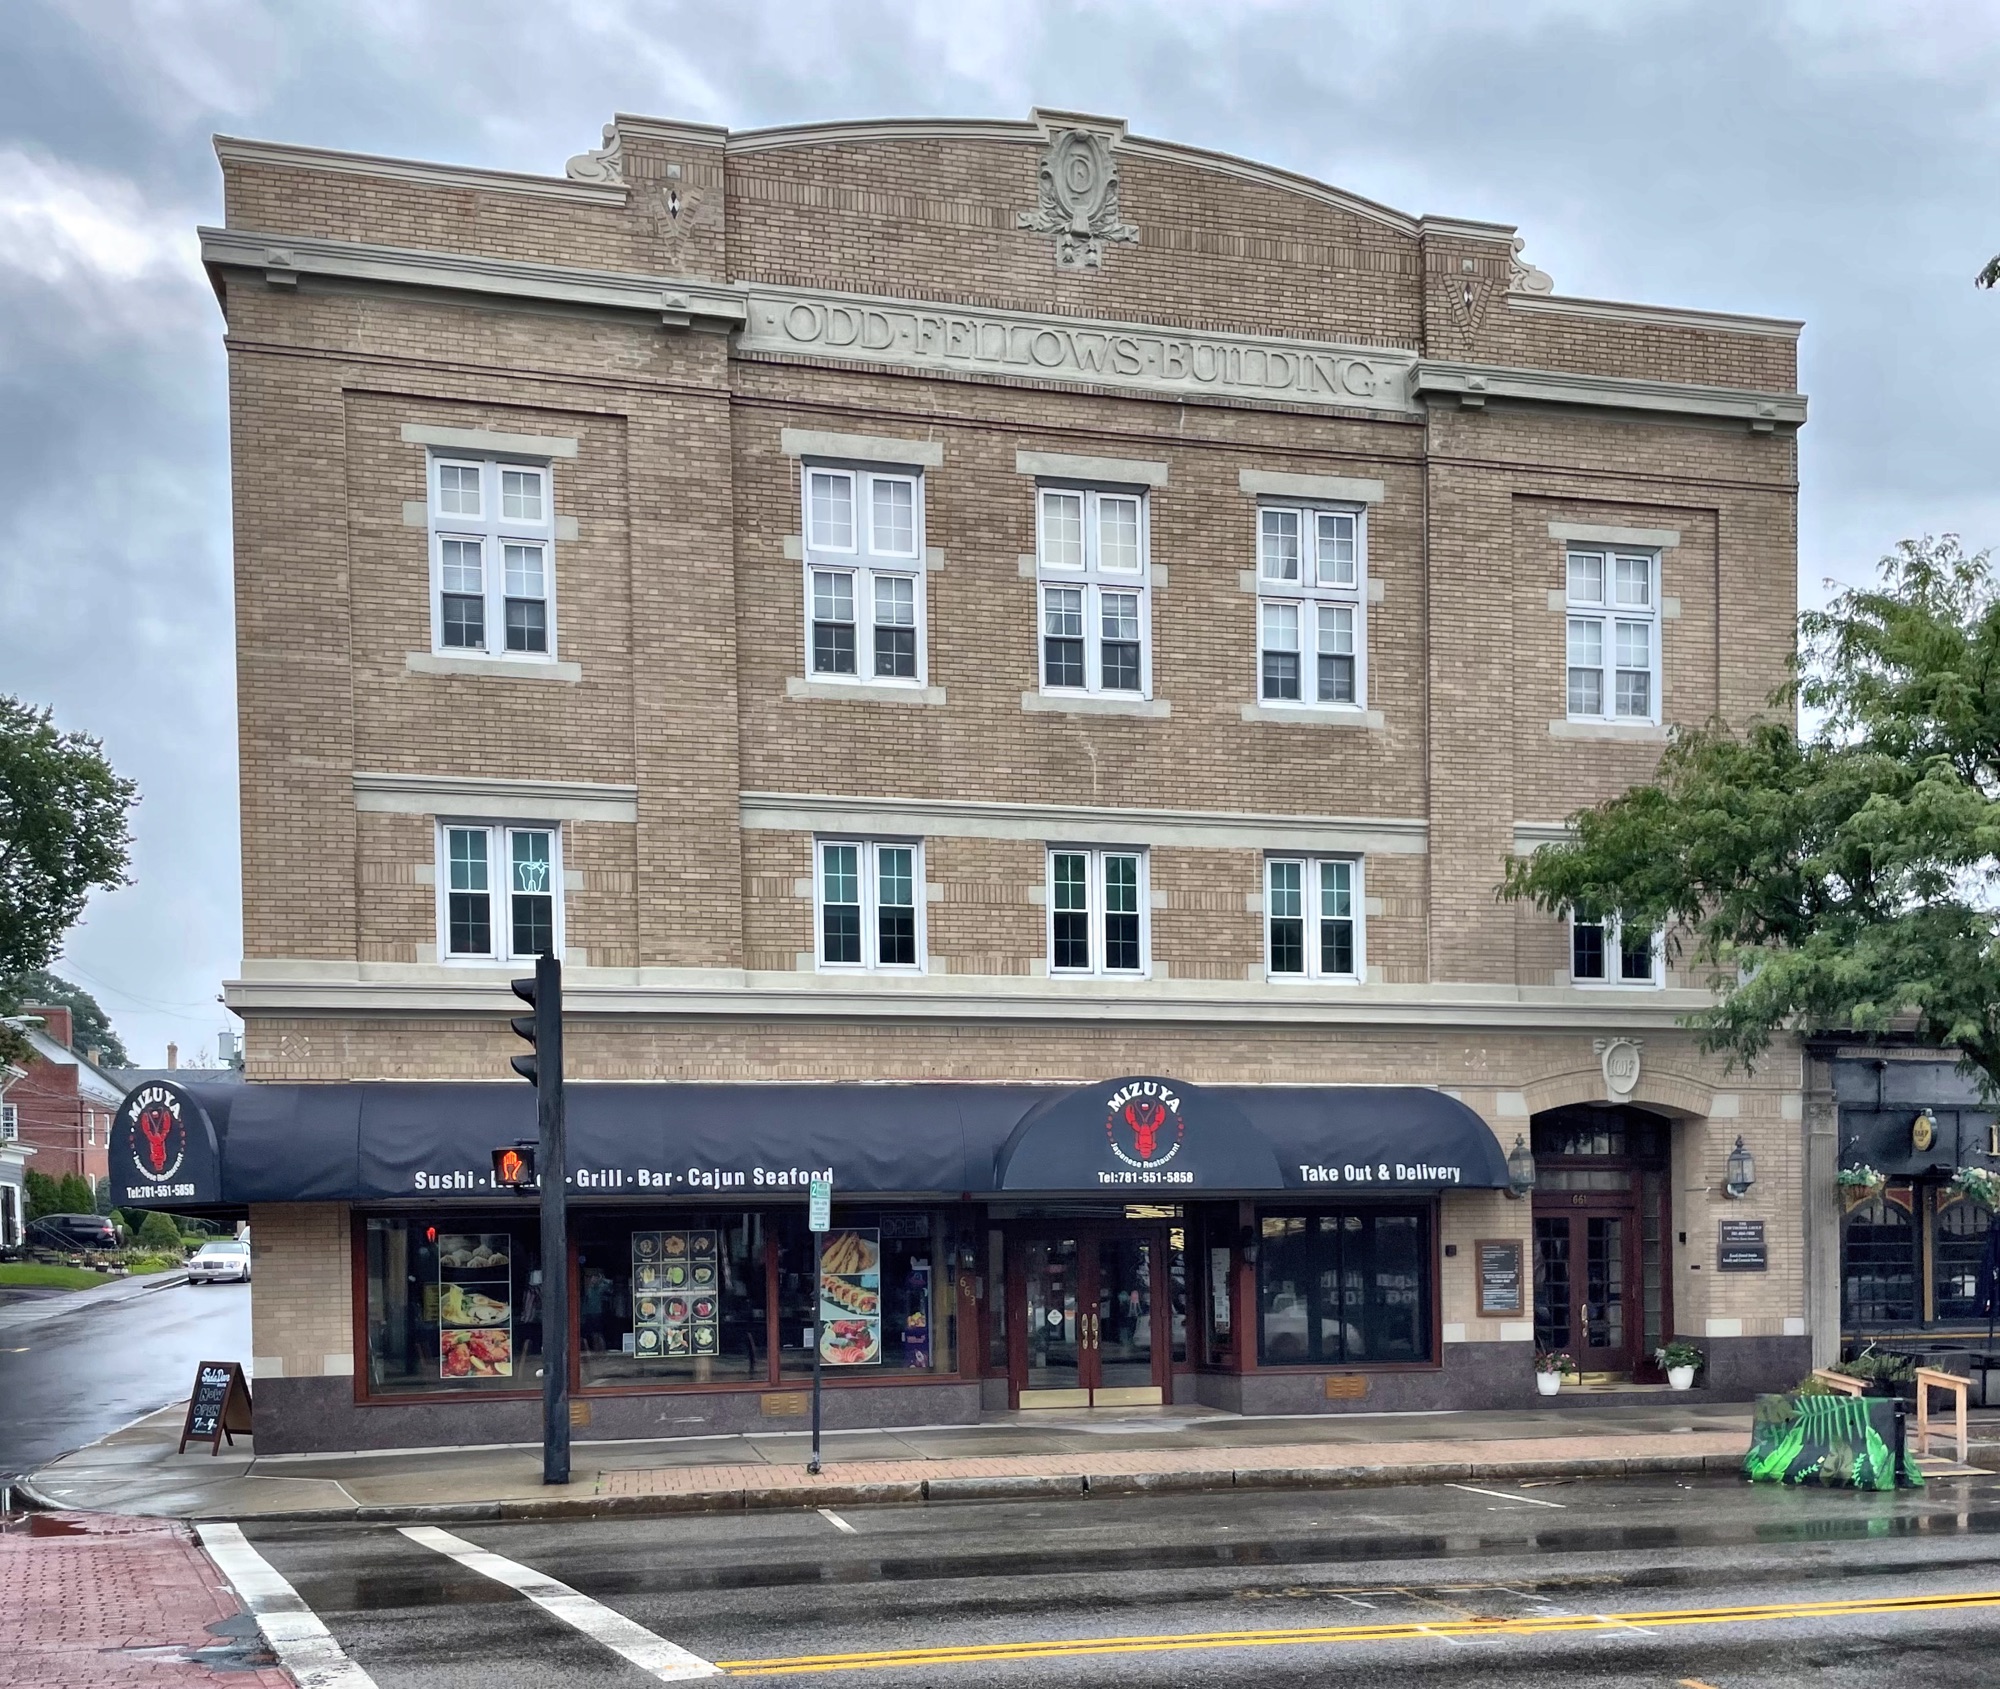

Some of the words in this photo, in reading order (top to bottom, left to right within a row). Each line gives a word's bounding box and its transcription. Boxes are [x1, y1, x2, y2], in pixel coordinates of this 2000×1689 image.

[784, 302, 896, 350] ODD
[913, 314, 1143, 376] FELLOWS
[1160, 341, 1376, 398] BUILDING
[128, 1086, 181, 1122] MIZUYA
[1107, 1081, 1180, 1113] MIZUYA
[1110, 1142, 1142, 1168] Japanese
[1143, 1142, 1181, 1169] Restaurant
[414, 1170, 474, 1190] Sushi
[576, 1168, 622, 1188] Grill
[638, 1168, 673, 1187] Bar
[688, 1167, 745, 1190] Cajun
[752, 1166, 834, 1186] Seafood
[1098, 1171, 1195, 1183] Tel:781-551-5858
[1299, 1164, 1339, 1182] Take
[1344, 1163, 1373, 1182] Out
[1377, 1163, 1391, 1181] &
[1395, 1163, 1461, 1184] Delivery
[126, 1183, 196, 1199] Tel:781-551-5858
[811, 1183, 817, 1196] 2
[960, 1276, 976, 1306] 663
[193, 1403, 221, 1417] OPEN
